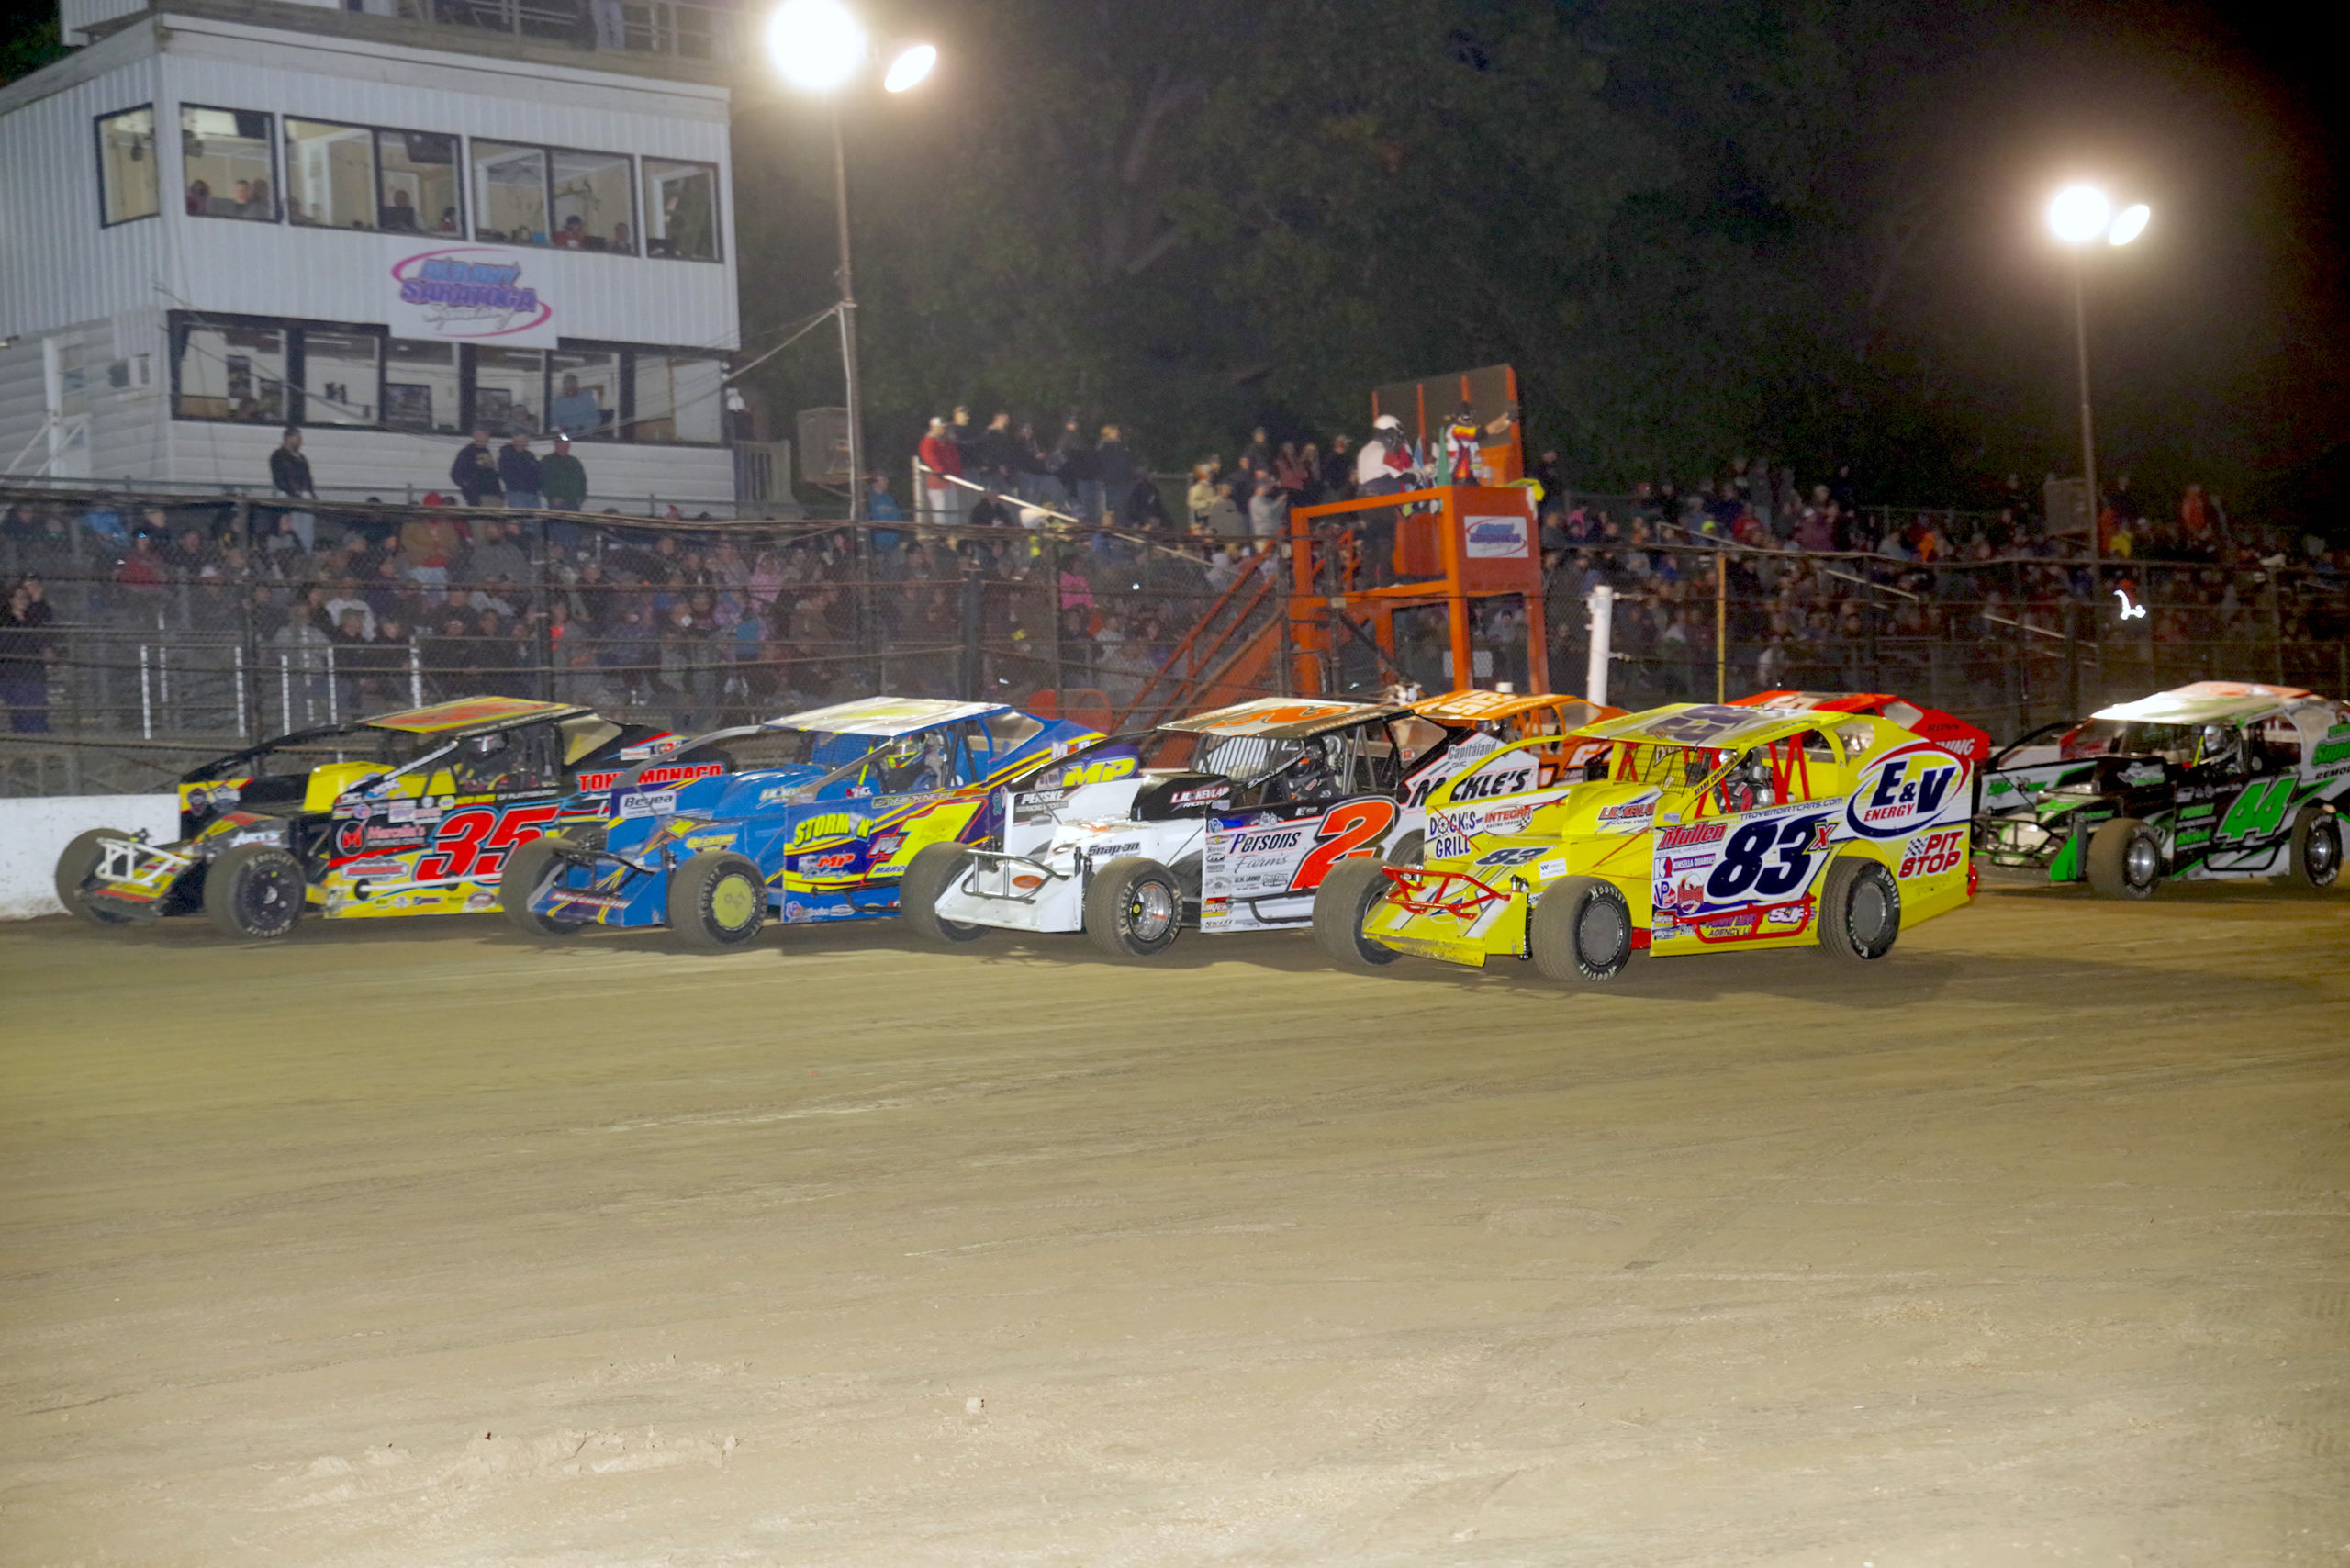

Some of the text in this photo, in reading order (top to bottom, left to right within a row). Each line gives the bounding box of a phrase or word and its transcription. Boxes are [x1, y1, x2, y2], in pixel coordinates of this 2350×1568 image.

[1448, 742, 1497, 761] Capitaland
[577, 764, 722, 792] TON MONACO
[1062, 757, 1136, 787] MP
[1021, 790, 1065, 805] PENSKE
[1408, 768, 1531, 809] MCKLE'S
[1870, 760, 1957, 814] E&V
[624, 793, 673, 810] Beyea
[1863, 803, 1915, 822] ENERGY
[2215, 777, 2298, 842] 44
[1484, 808, 1531, 823] INTEGRA
[416, 805, 561, 883] 35
[1229, 831, 1302, 855] Persons
[1289, 797, 1396, 890] 2
[1436, 836, 1471, 858] GRILL
[1658, 823, 1728, 849] Mullen
[1924, 830, 1964, 855] PIT
[817, 853, 856, 868] MP
[1087, 842, 1140, 857] Snap-on
[1474, 846, 1550, 866] 83
[1707, 816, 1816, 898] 83
[1235, 854, 1290, 874] Farms
[1898, 850, 1963, 879] STOP
[1708, 928, 1741, 936] AGENCY
